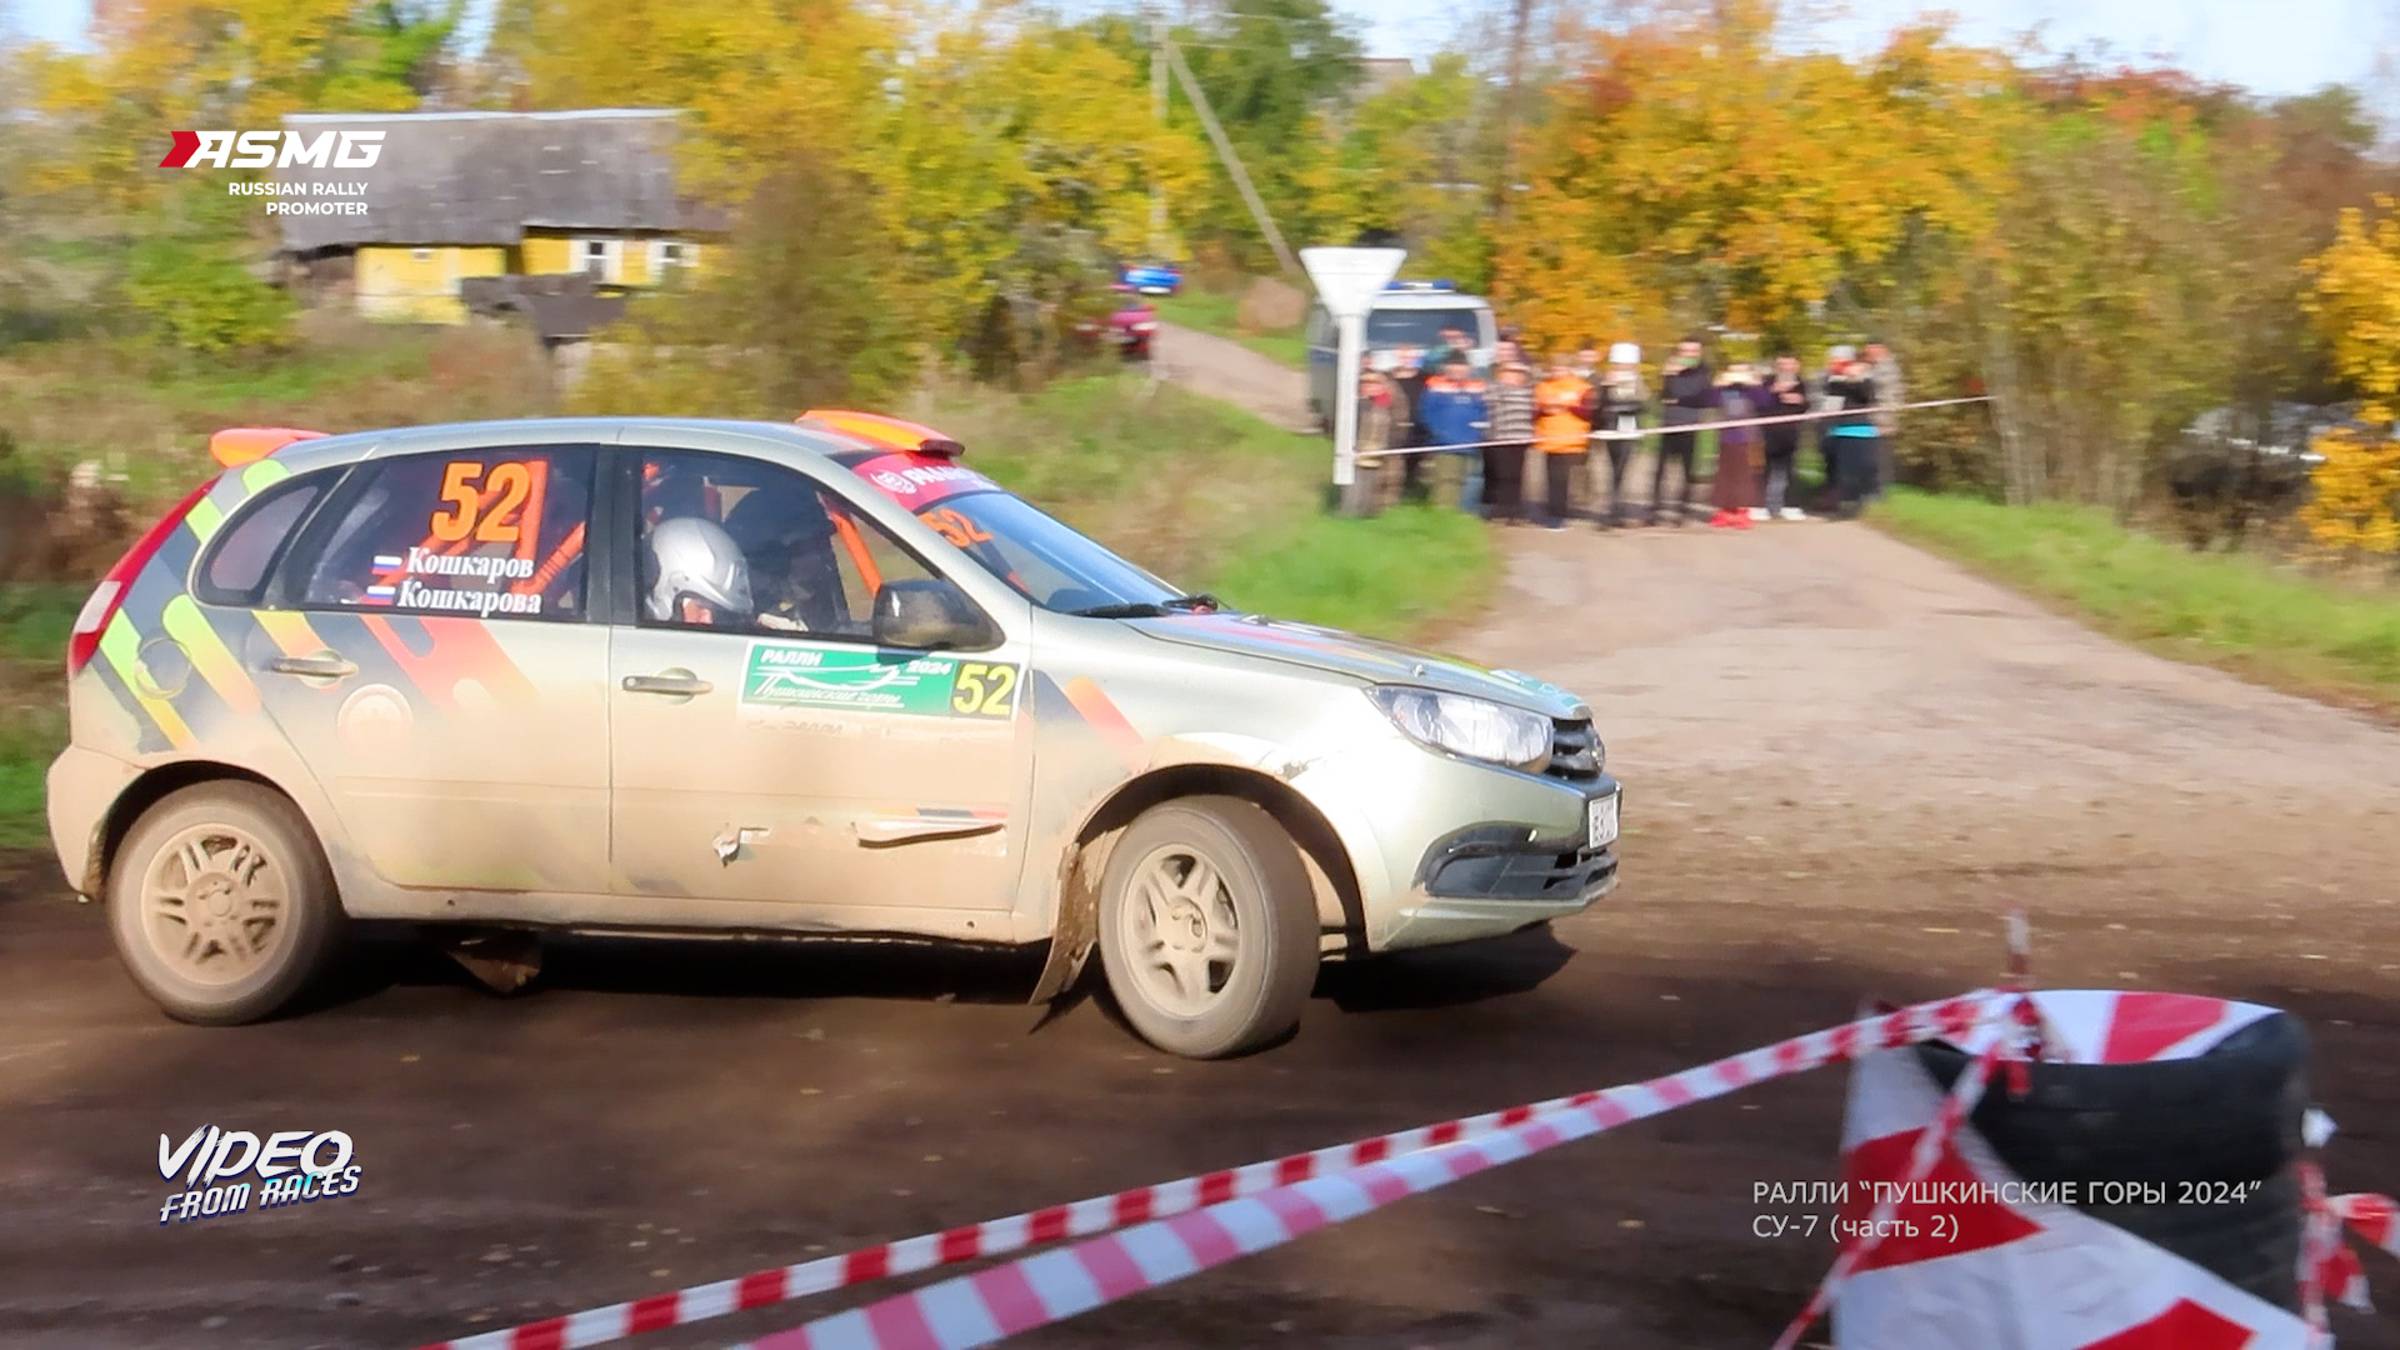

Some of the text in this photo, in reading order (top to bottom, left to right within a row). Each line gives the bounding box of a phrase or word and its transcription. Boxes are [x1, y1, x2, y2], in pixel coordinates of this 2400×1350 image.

[431, 461, 531, 542] 52
[917, 507, 994, 548] 52
[405, 546, 535, 584] Кошкаров
[396, 579, 543, 619] Кошкарова
[760, 648, 953, 676] РАЛЛИ 2024
[952, 663, 1017, 716] 52
